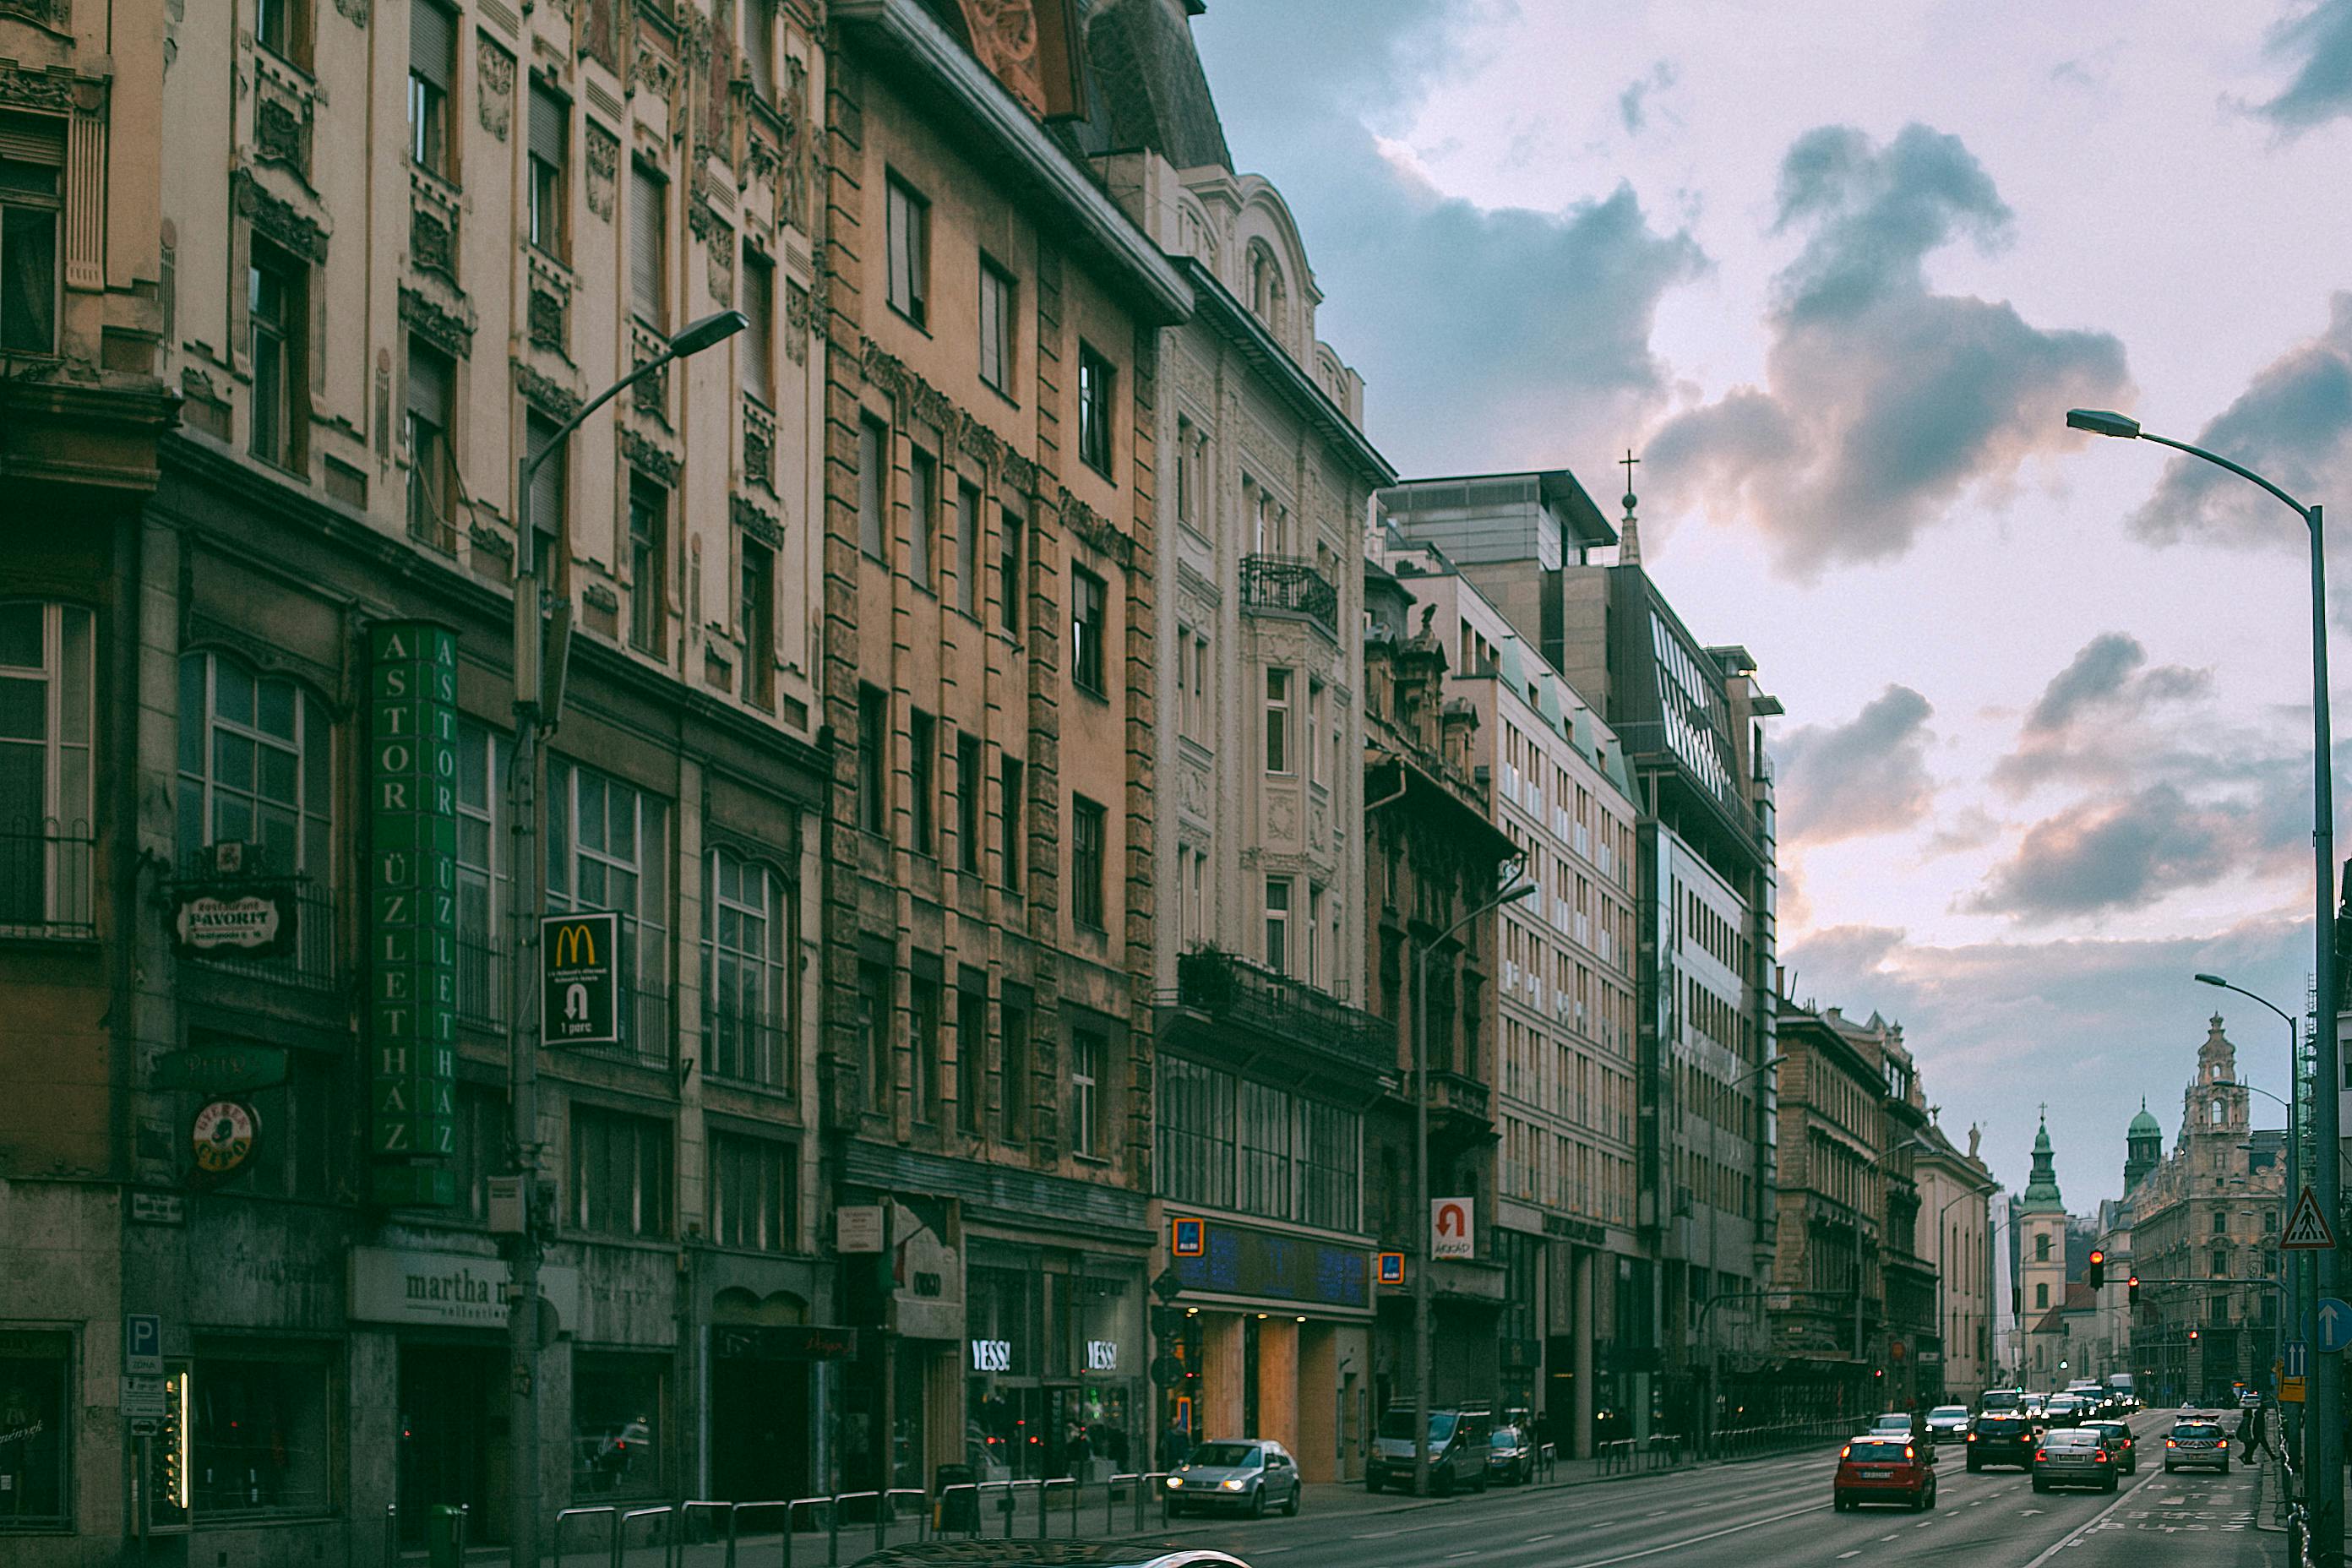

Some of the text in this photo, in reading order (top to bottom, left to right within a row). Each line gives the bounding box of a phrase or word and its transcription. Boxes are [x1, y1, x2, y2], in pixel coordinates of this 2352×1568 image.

[383, 634, 408, 1150] ASTOR ÜZLETHÁZ
[438, 638, 454, 1153] ASTOR ÜZLETHÁZ
[189, 912, 268, 926] FAVORIT
[406, 1267, 487, 1304] martha
[134, 1320, 152, 1352] P
[972, 1340, 1010, 1371] YESS!
